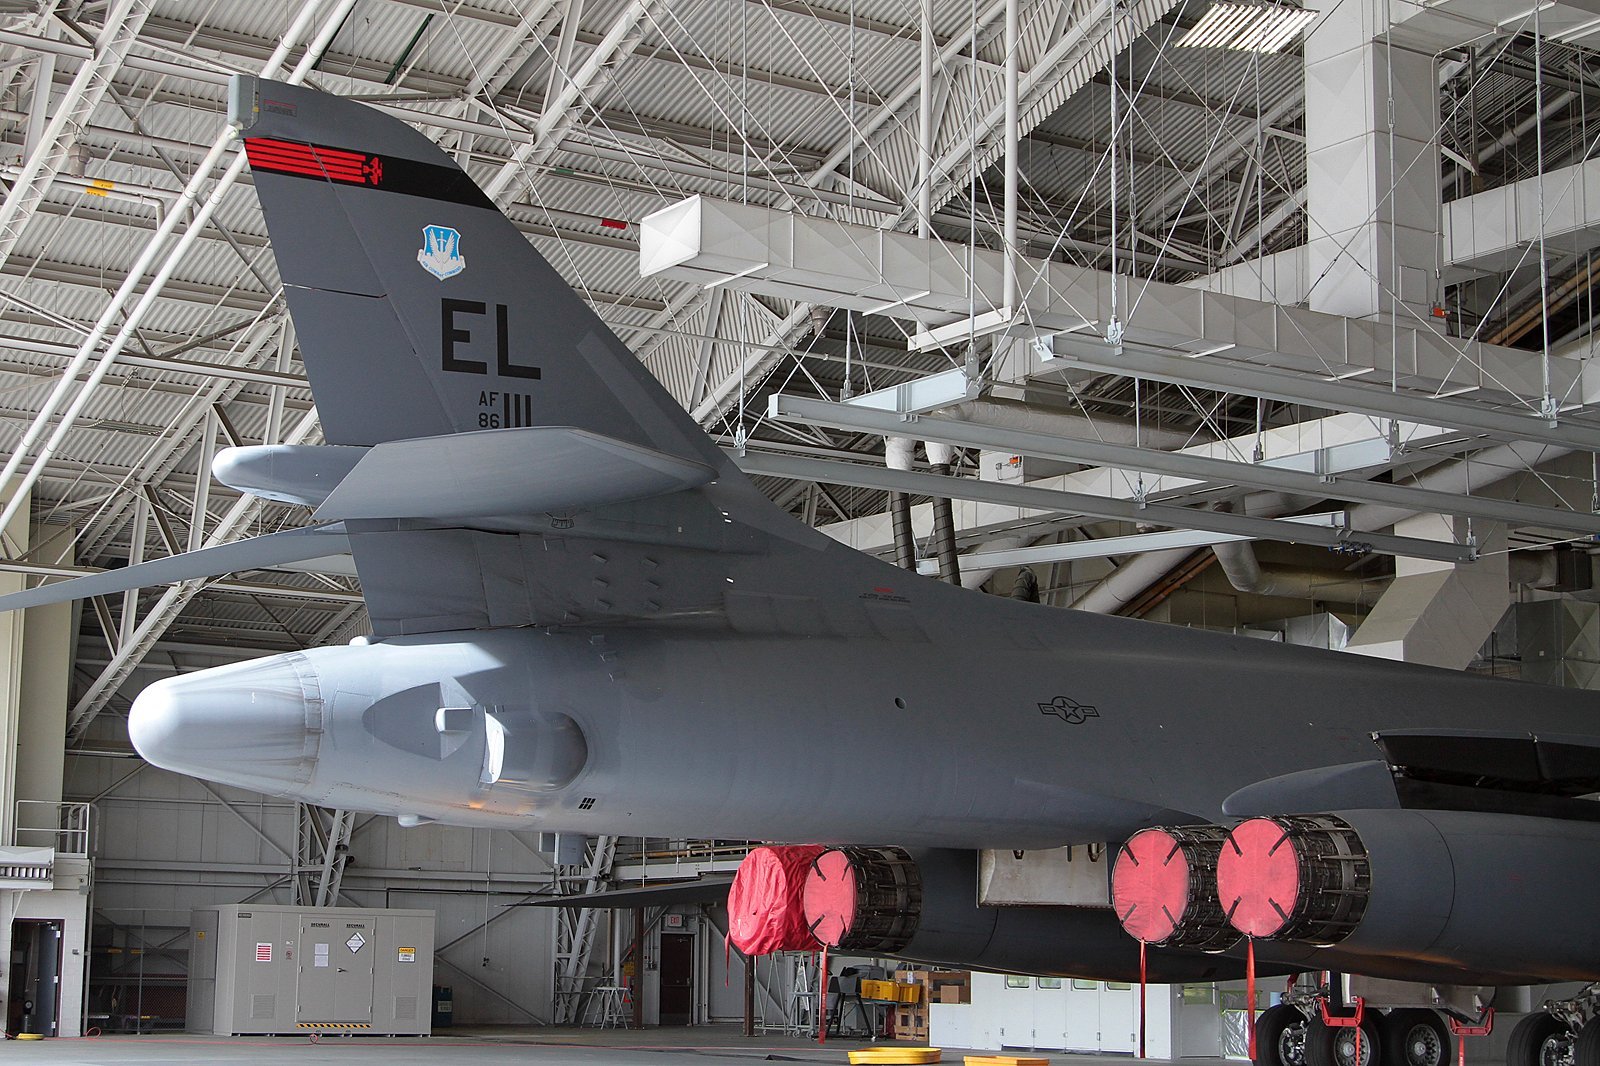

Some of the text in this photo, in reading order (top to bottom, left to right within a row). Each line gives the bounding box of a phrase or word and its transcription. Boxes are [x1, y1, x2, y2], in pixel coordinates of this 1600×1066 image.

[441, 297, 541, 380] EL
[478, 390, 499, 407] AF
[478, 412, 500, 429] 86
